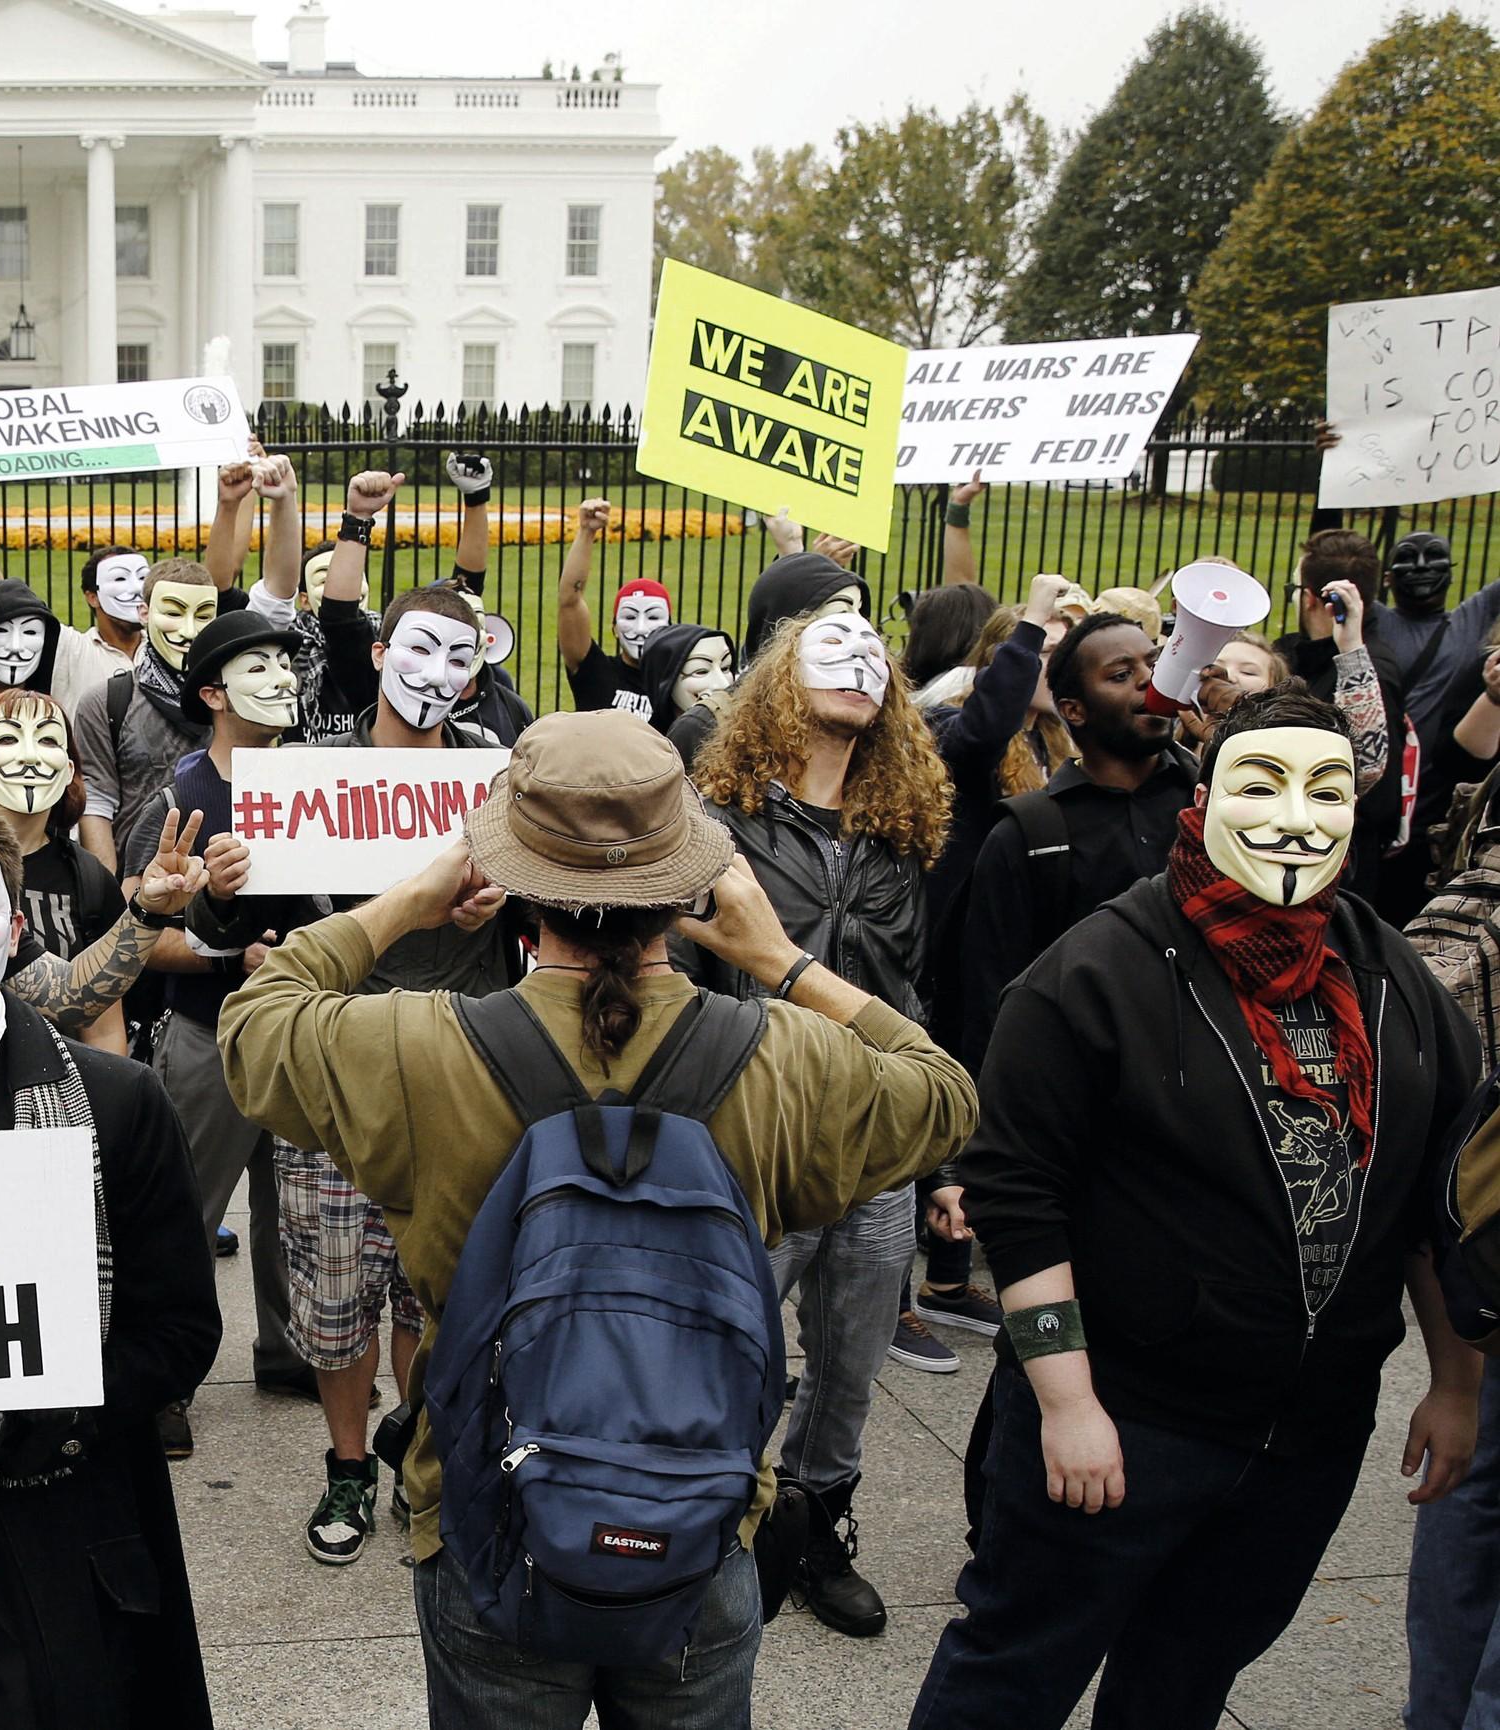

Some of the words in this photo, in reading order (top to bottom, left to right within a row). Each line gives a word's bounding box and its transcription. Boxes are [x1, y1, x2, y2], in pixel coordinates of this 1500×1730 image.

[1420, 316, 1500, 354] TP
[695, 319, 767, 385] WE
[782, 359, 871, 427] ARE
[907, 361, 962, 385] ALL
[983, 356, 1078, 382] WARS
[1083, 351, 1156, 377] ARE
[901, 396, 1027, 423] ANKERS
[1064, 390, 1167, 418] WARS
[1364, 377, 1403, 414] IS
[1444, 367, 1494, 402] CO
[1430, 399, 1500, 441] FOR
[682, 396, 864, 492] AWAKE
[949, 441, 1011, 467] THE
[1030, 433, 1130, 466] FED!!
[24, 889, 77, 945] TH
[603, 1535, 659, 1551] EASTPAK
